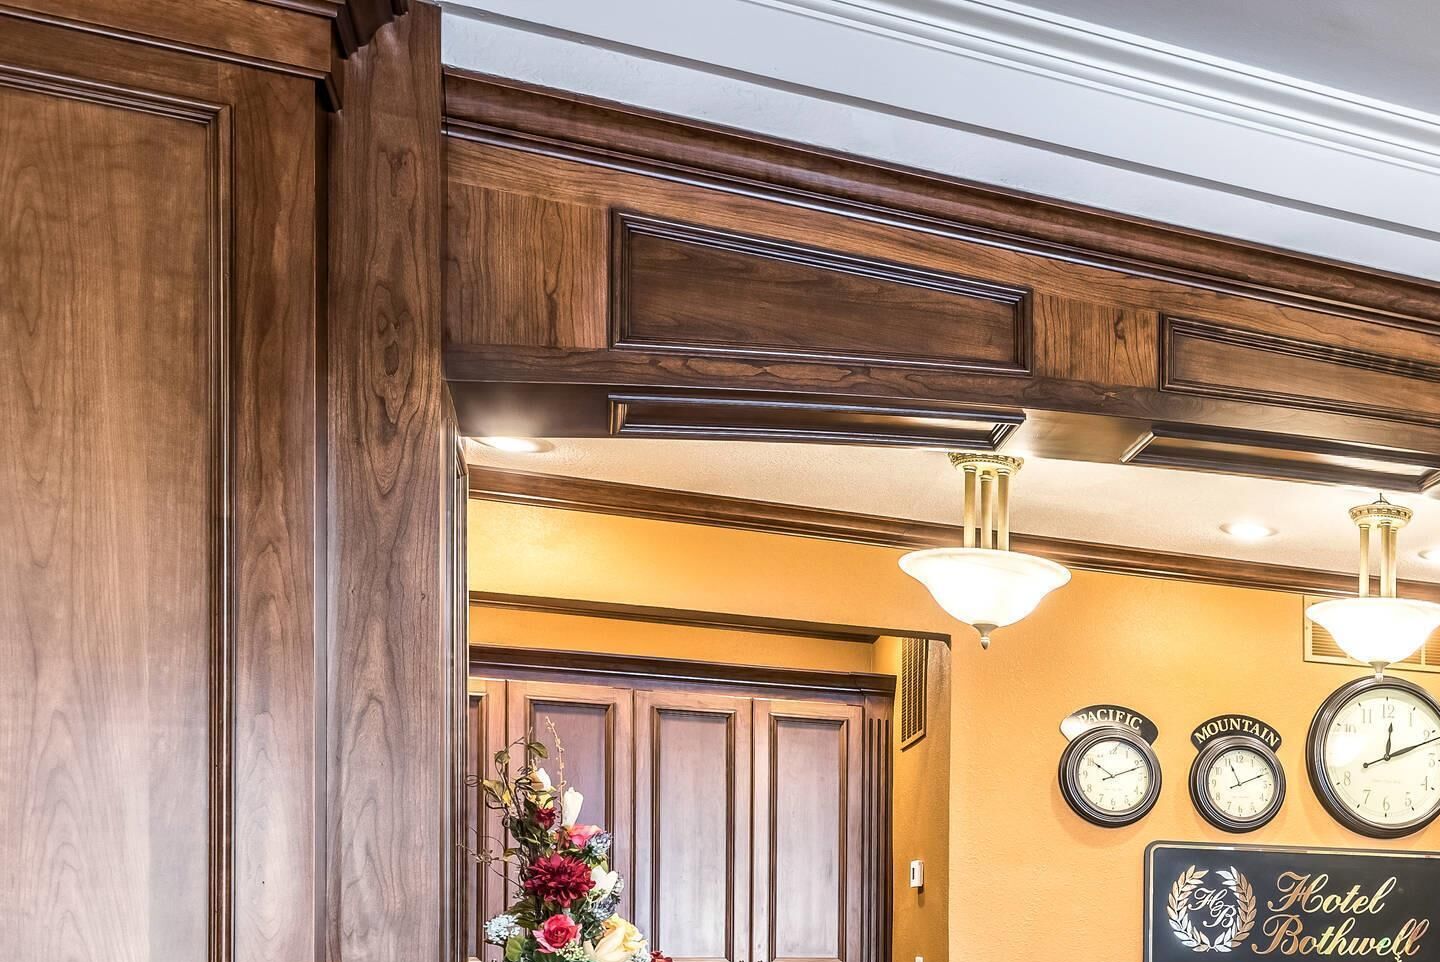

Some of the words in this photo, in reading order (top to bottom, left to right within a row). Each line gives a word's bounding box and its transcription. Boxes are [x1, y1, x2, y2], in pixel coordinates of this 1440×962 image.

[1077, 709, 1142, 730] PACIFIC
[1362, 708, 1372, 724] 11
[1382, 703, 1395, 719] 12
[1194, 718, 1279, 747] MOUNTAIN
[1363, 789, 1371, 804] 7
[1267, 871, 1397, 914] Hotel
[1251, 914, 1430, 955] Bothwell
